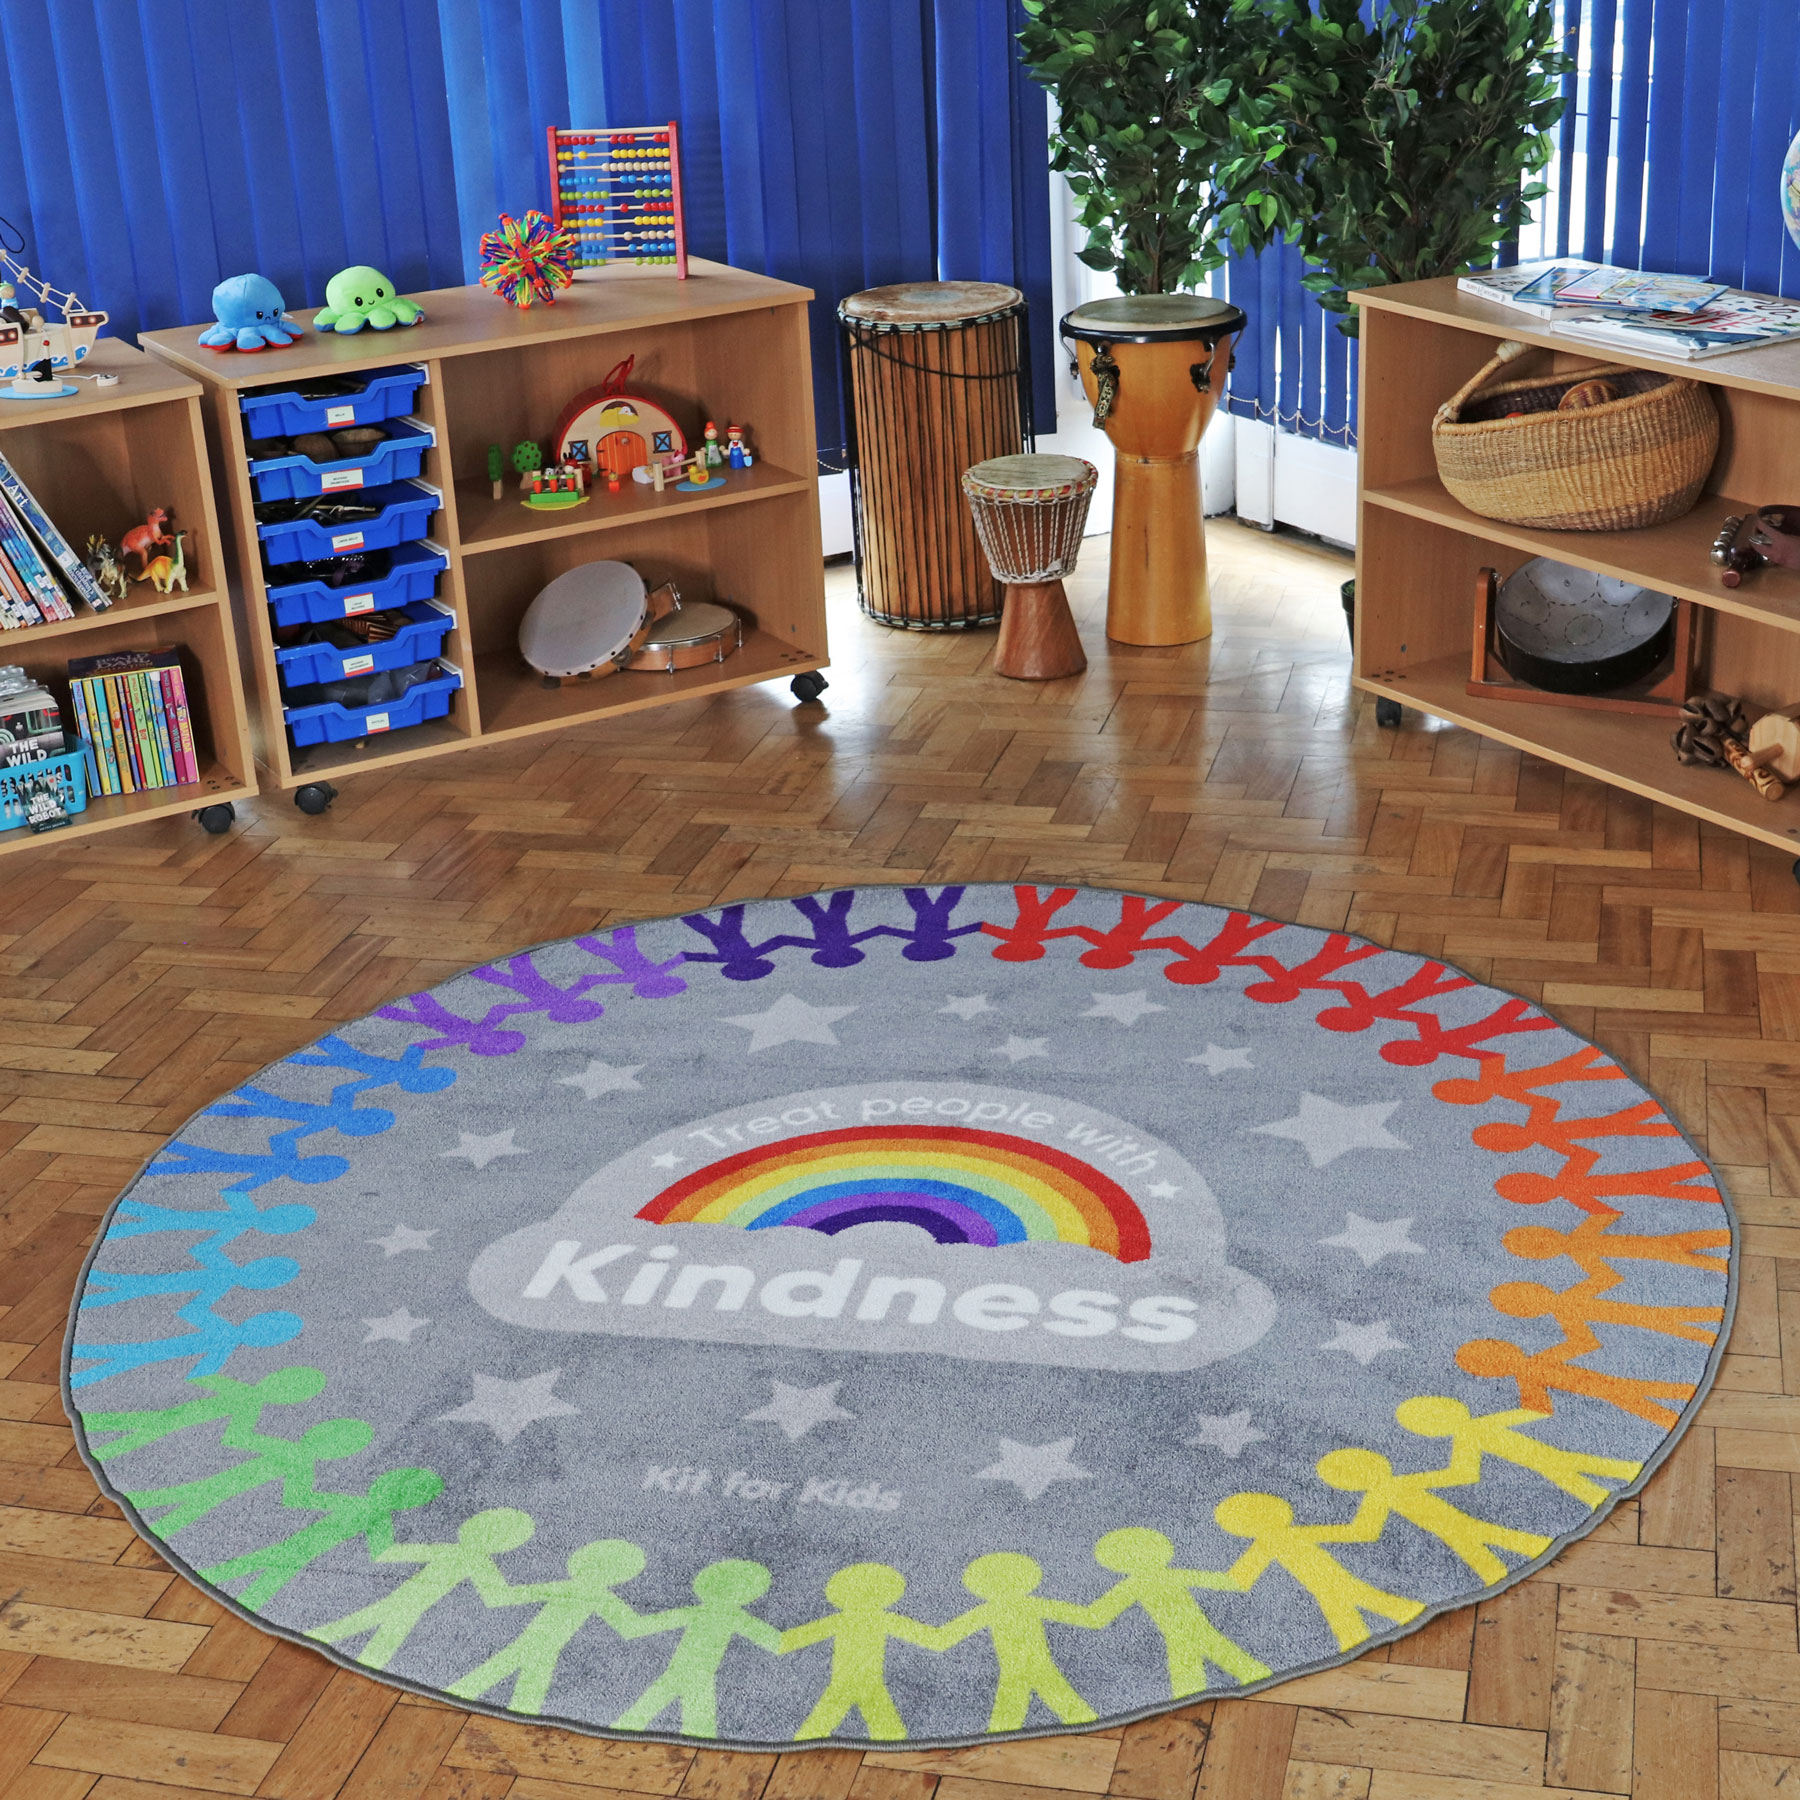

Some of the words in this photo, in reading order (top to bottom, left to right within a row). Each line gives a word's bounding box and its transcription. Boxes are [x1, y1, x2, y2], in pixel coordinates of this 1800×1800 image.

[7, 484, 31, 508] Art
[139, 728, 148, 741] BOY
[179, 721, 193, 753] MATILDA
[9, 738, 39, 754] THE
[6, 749, 47, 768] WILD
[28, 800, 57, 814] WILD
[30, 793, 50, 805] THE
[28, 807, 61, 824] ROBOT
[688, 1101, 840, 1150] Treat
[862, 1096, 1055, 1130] people
[1066, 1124, 1158, 1176] with
[523, 1240, 1199, 1343] Kindness
[642, 1466, 711, 1492] Kit
[723, 1471, 794, 1499] for
[800, 1476, 901, 1512] Kids
